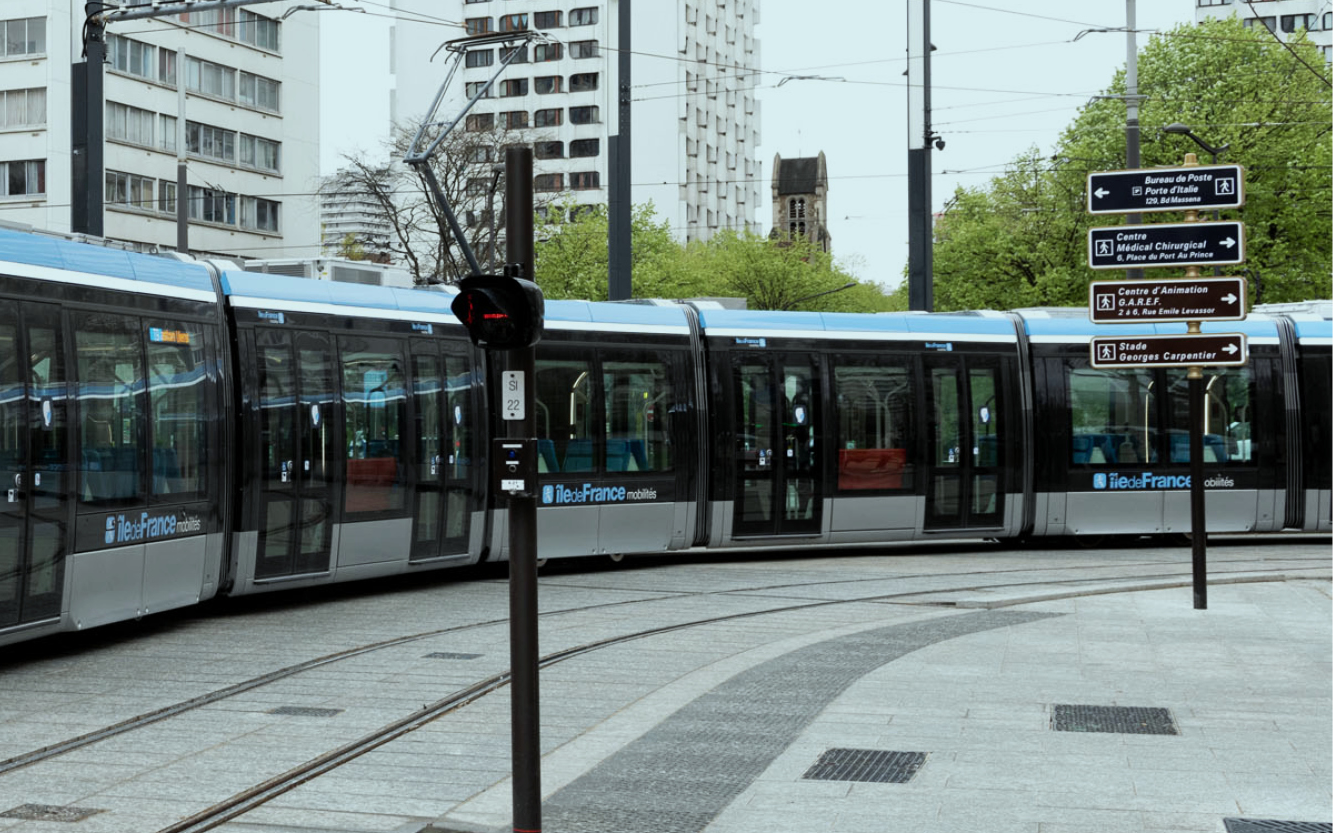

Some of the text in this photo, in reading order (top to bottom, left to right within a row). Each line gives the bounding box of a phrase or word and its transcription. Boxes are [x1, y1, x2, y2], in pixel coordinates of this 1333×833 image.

[1145, 173, 1213, 185] Bureau de Poste
[1145, 185, 1199, 195] Porte d'Italie
[1146, 197, 1159, 205] 129,
[1116, 232, 1147, 241] Centre
[1116, 240, 1207, 252] Médical Chirurgical
[1126, 253, 1146, 261] Place
[1159, 252, 1176, 260] Port
[1189, 251, 1214, 259] Prince
[1118, 285, 1208, 296] Centre d'Animation
[1118, 297, 1162, 307] G.A.R.E.F.
[1141, 308, 1157, 316] Rue
[1158, 307, 1180, 315] Emile
[1181, 307, 1215, 315] Levassor
[1119, 342, 1147, 351] Stade
[1119, 351, 1217, 363] Georges Carpentier
[508, 380, 518, 391] SI
[507, 399, 520, 411] 22
[626, 488, 657, 500] mobilités
[176, 517, 201, 533] mobilités
